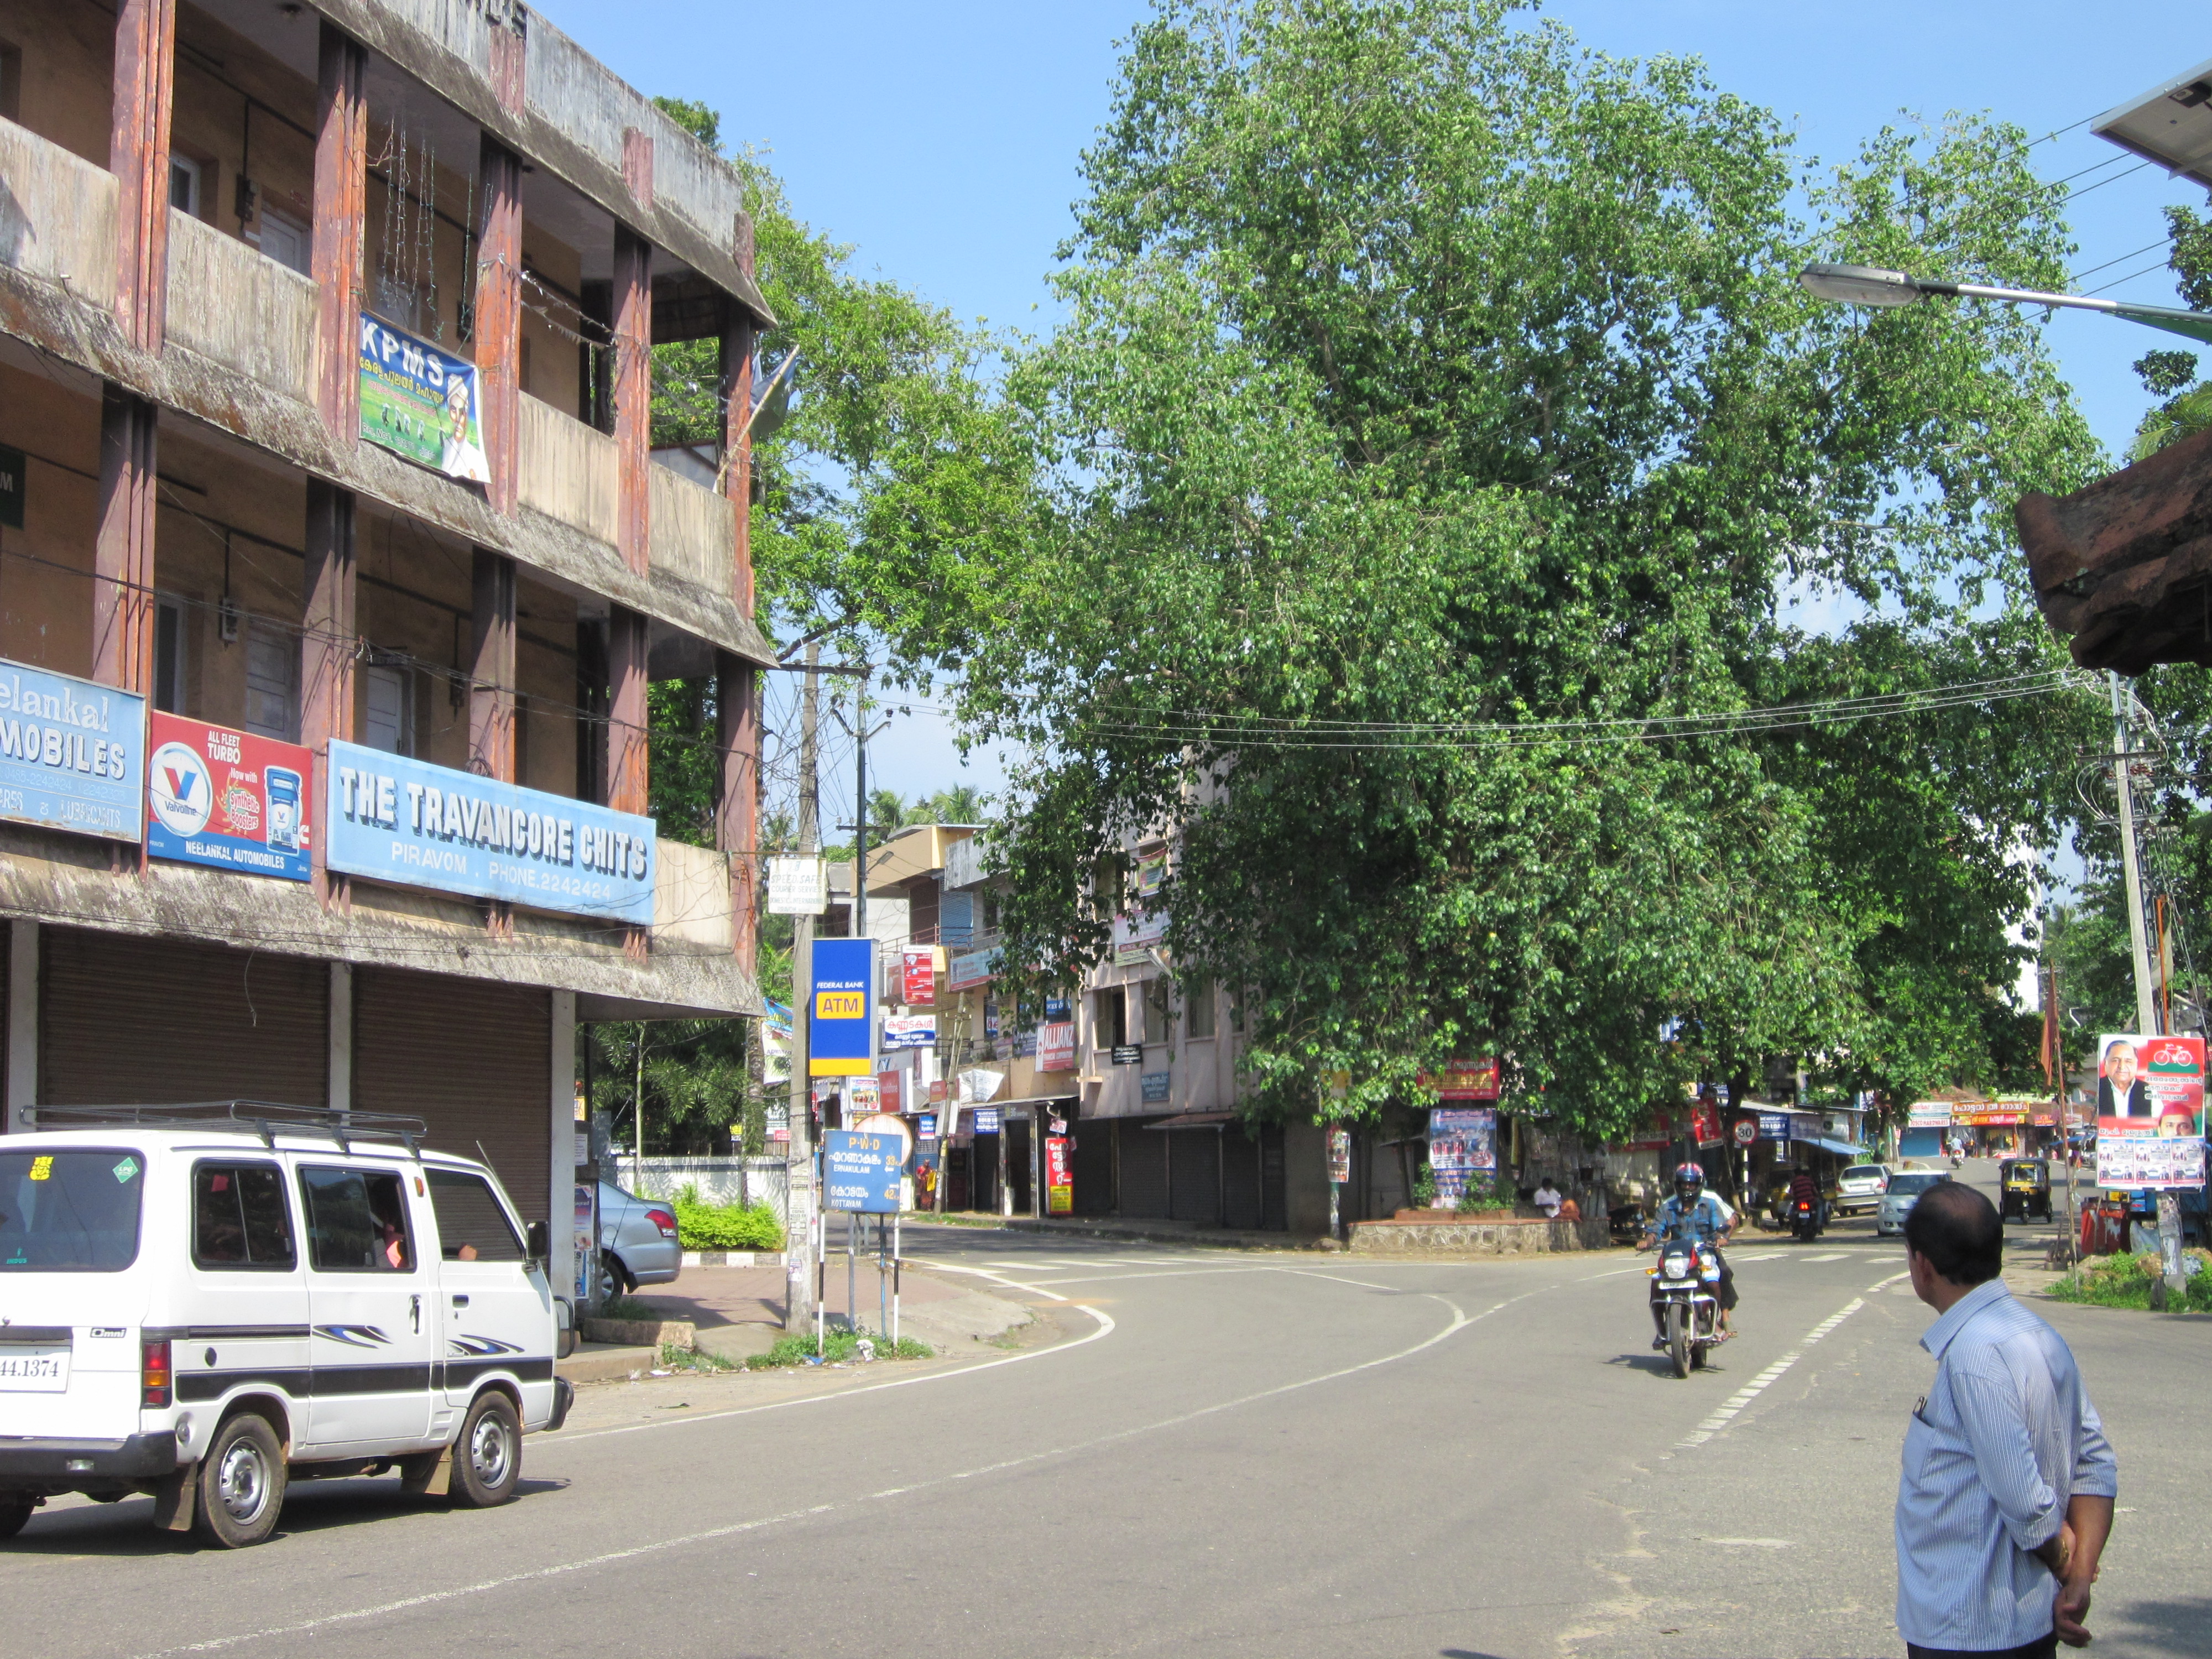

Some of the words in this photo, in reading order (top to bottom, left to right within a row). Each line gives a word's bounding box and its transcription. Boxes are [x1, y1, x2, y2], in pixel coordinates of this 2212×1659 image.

[360, 317, 444, 386] KPMS
[208, 730, 220, 744] ALL
[222, 732, 240, 748] FLEET
[207, 743, 241, 764] TURBO
[231, 767, 244, 780] Now
[245, 771, 257, 784] with
[165, 801, 196, 816] Valvoline
[229, 791, 259, 813] Synthetic
[60, 800, 121, 828] LUBRICANTS
[231, 809, 259, 830] Boosters
[340, 766, 397, 830] THE
[407, 782, 572, 865] TRAVANCORE
[580, 825, 646, 880] CHITS
[185, 840, 231, 861] NEELANKAL
[234, 849, 284, 869] AUTOMOBILES
[392, 841, 466, 875] PIRAVOM
[822, 998, 858, 1013] ATM
[1044, 1025, 1074, 1050] ALLIANZ
[1739, 1128, 1752, 1138] 30
[833, 1164, 870, 1174] ERNAKULAM
[831, 1199, 862, 1208] KOTTAYAM
[884, 1189, 894, 1199] 42
[91, 1328, 125, 1337] Omni
